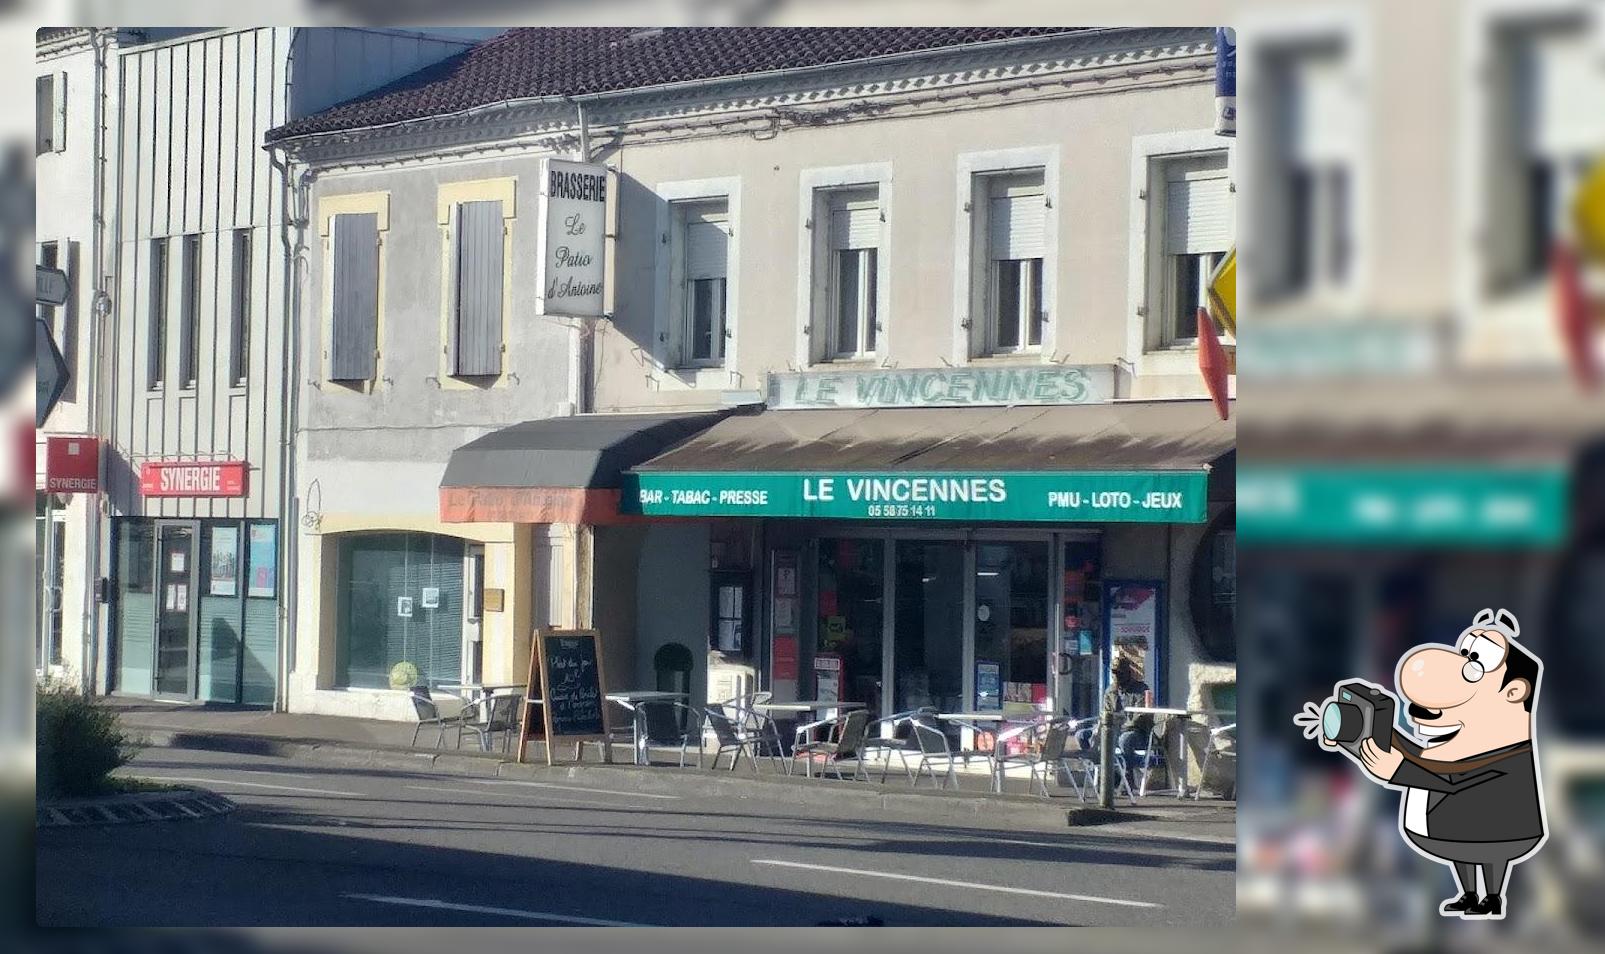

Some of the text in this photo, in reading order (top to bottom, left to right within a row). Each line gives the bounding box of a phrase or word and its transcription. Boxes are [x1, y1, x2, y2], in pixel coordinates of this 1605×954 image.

[550, 171, 605, 201] BRASSERIE
[565, 213, 585, 235] Le
[556, 246, 592, 268] Patio
[548, 277, 602, 299] d'Antoine
[795, 368, 1091, 404] LE VINCENNES
[50, 477, 97, 489] SYNERGIE
[160, 466, 221, 492] SYNERGIE
[639, 489, 663, 503] BAR
[671, 490, 711, 505] TABAC
[719, 490, 768, 505] PRESSE
[803, 478, 1007, 503] LE VINCENNES
[1048, 491, 1081, 508] PMU
[1091, 491, 1131, 509] LOTO
[1141, 492, 1183, 509] JEUX
[868, 505, 881, 517] 05
[911, 505, 923, 517] 14
[925, 505, 936, 517] 11
